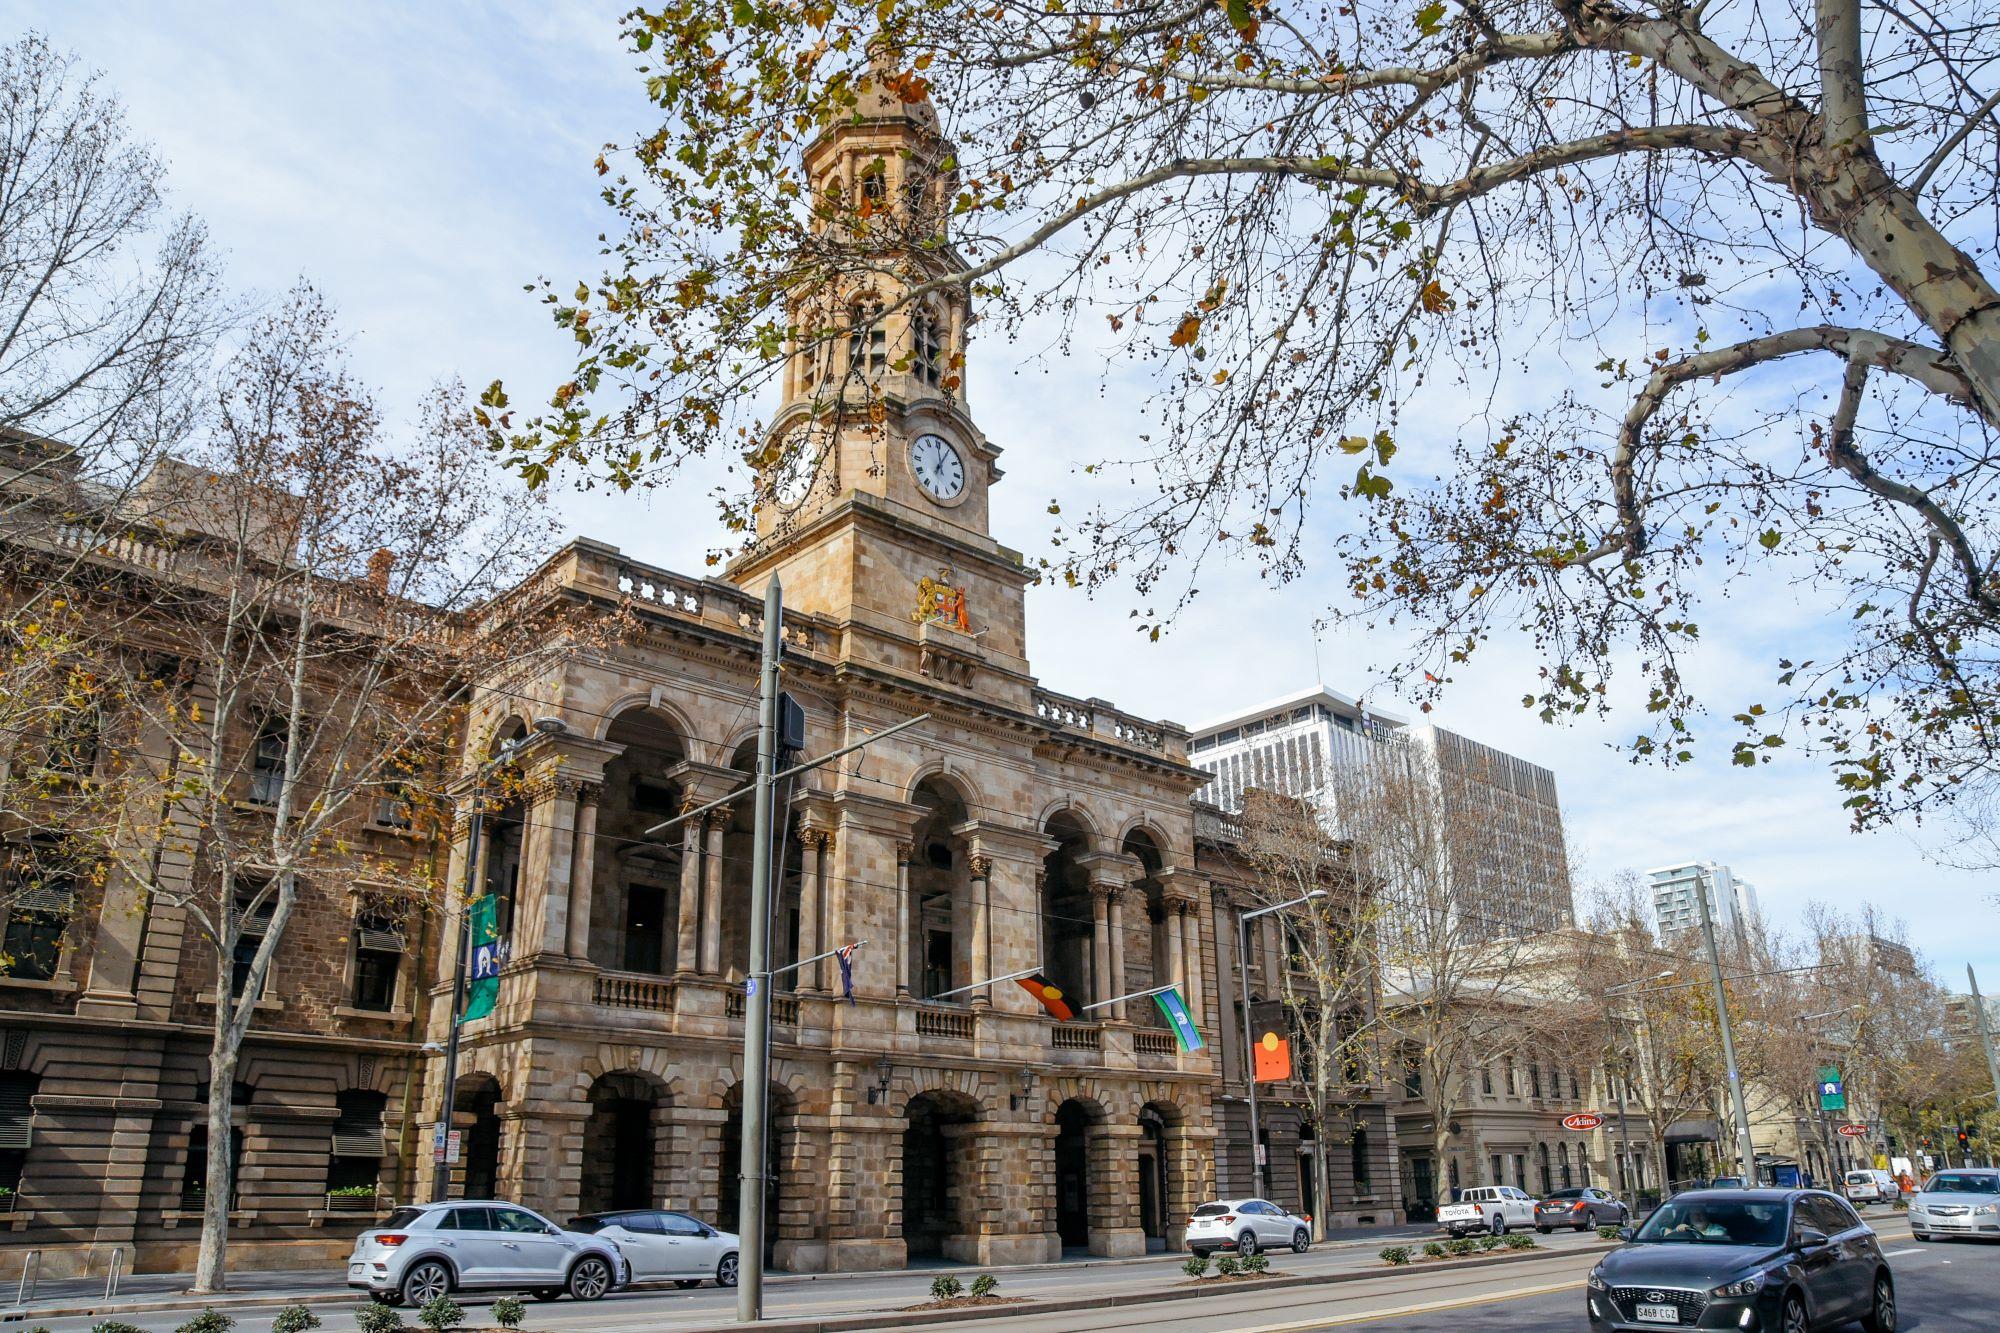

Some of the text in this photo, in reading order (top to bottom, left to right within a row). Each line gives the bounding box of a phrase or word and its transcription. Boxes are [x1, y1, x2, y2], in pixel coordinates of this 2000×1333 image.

[1568, 1116, 1596, 1126] Adina
[1444, 1208, 1470, 1216] TOYOTA
[1659, 1308, 1676, 1319] CGZ
